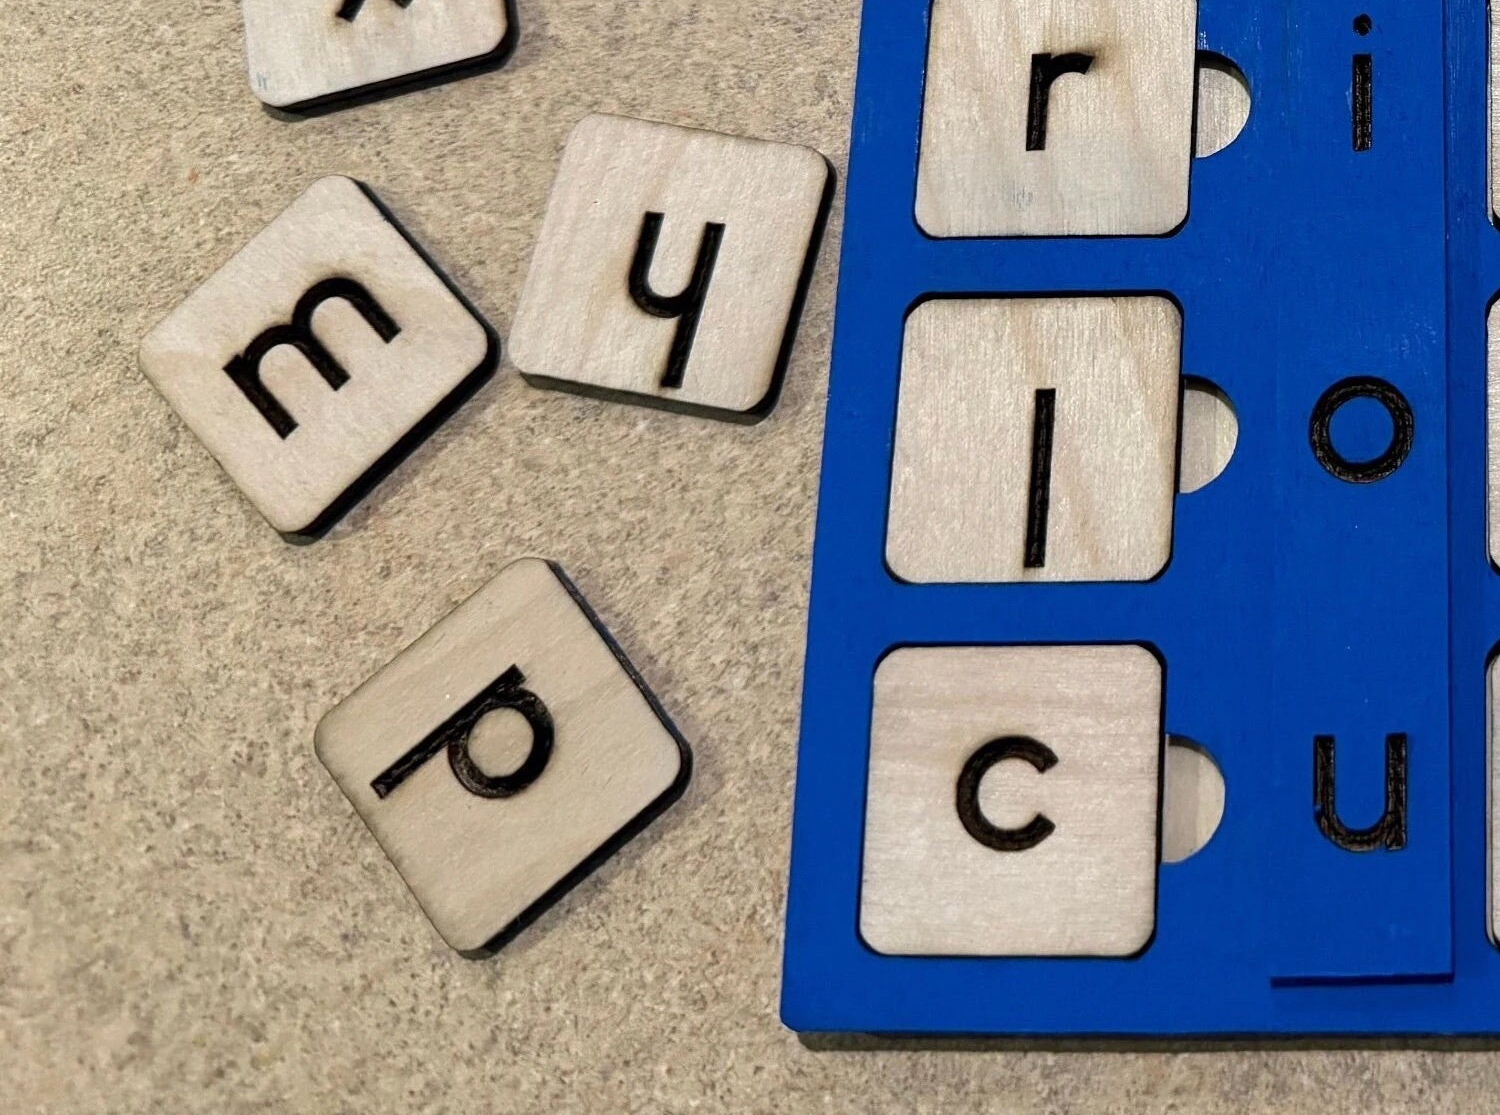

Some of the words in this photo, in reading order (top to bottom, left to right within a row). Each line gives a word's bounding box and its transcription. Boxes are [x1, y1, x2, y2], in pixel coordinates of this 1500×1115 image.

[1026, 51, 1098, 151] r
[1352, 14, 1372, 151] i
[222, 275, 401, 441] m
[1309, 376, 1414, 484] o
[956, 735, 1058, 852] c
[1313, 733, 1408, 853] u
